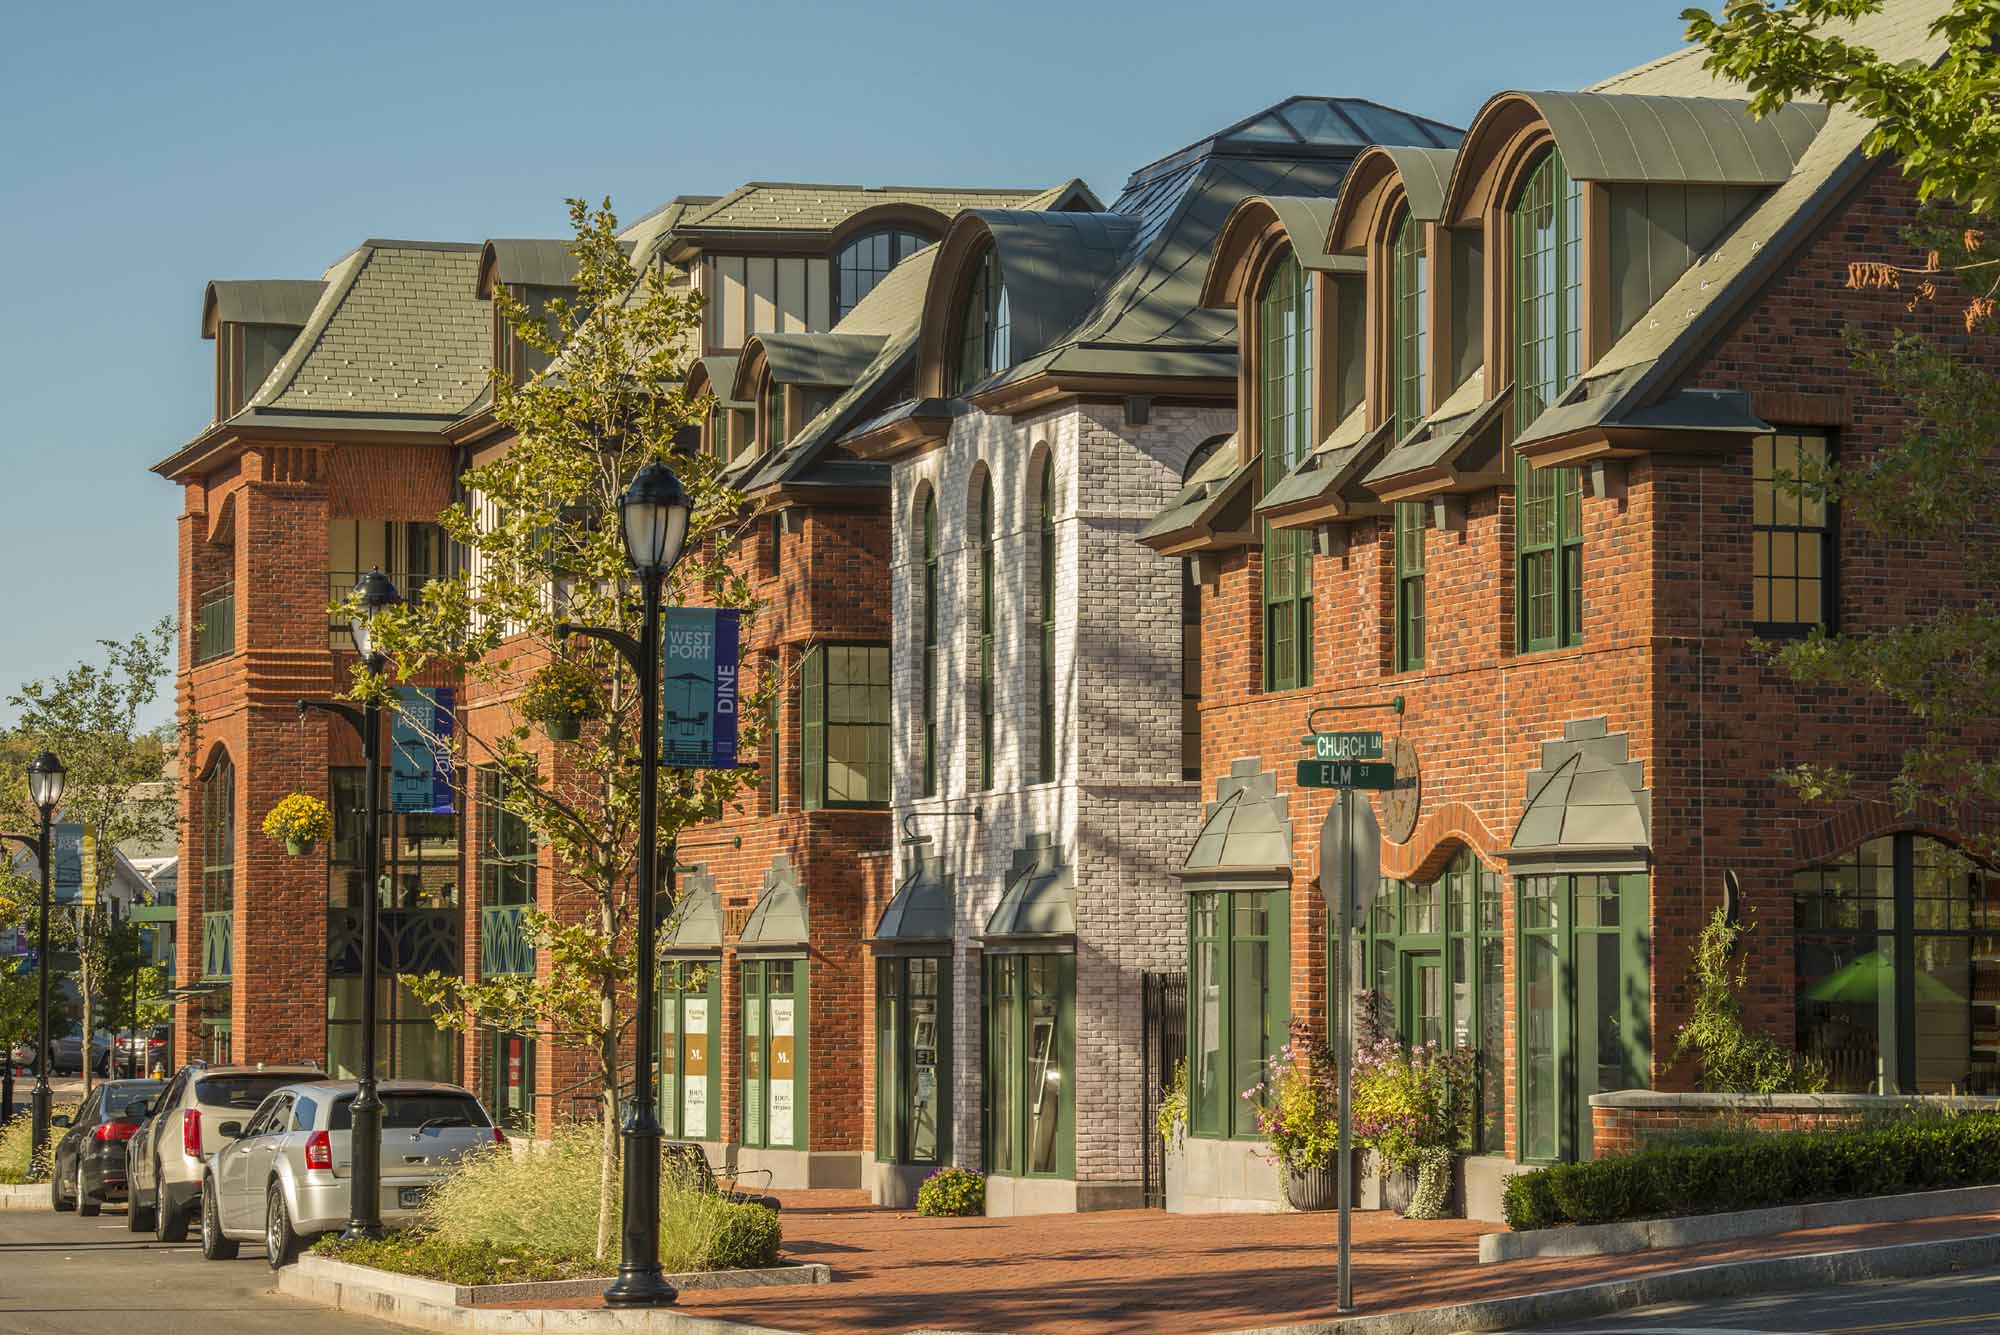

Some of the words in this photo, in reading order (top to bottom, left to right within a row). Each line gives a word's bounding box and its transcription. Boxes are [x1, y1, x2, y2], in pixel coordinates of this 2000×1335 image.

[670, 631, 712, 645] WEST
[670, 645, 711, 660] PORT
[717, 665, 735, 714] DINE
[1317, 736, 1367, 757] CHURCH
[1371, 735, 1381, 748] LN
[1320, 764, 1351, 785] ELM
[1359, 766, 1369, 777] ST
